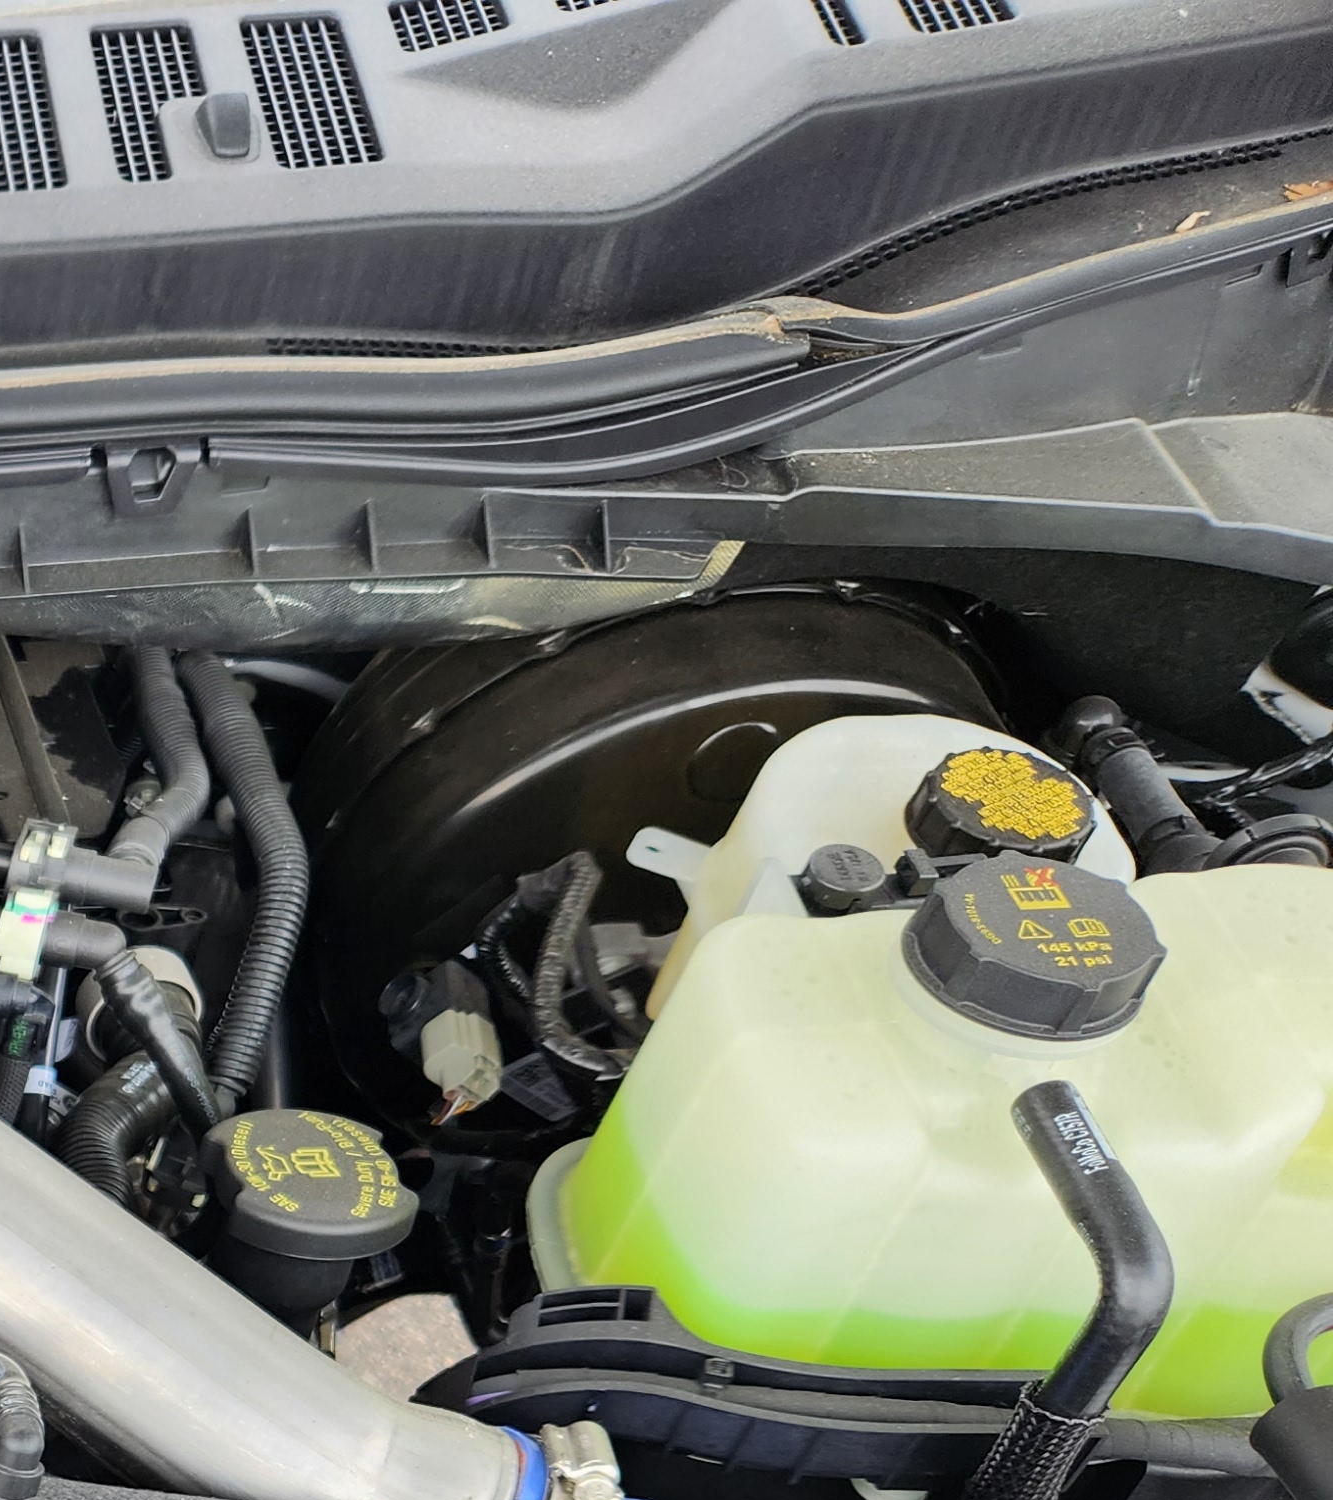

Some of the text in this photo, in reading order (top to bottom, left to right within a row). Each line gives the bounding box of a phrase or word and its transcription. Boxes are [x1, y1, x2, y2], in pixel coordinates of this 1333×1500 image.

[1037, 941, 1113, 953] 145 kPa
[1054, 955, 1113, 967] 21 psi
[231, 1120, 254, 1160] (Diesel)
[297, 1111, 355, 1149] Bio-Fuel
[331, 1118, 382, 1156] (Diesel)
[1053, 1110, 1110, 1175] FoMoCo C757R
[268, 1192, 300, 1213] SAE
[350, 1182, 375, 1218] Severe
[377, 1187, 397, 1208] SAE
